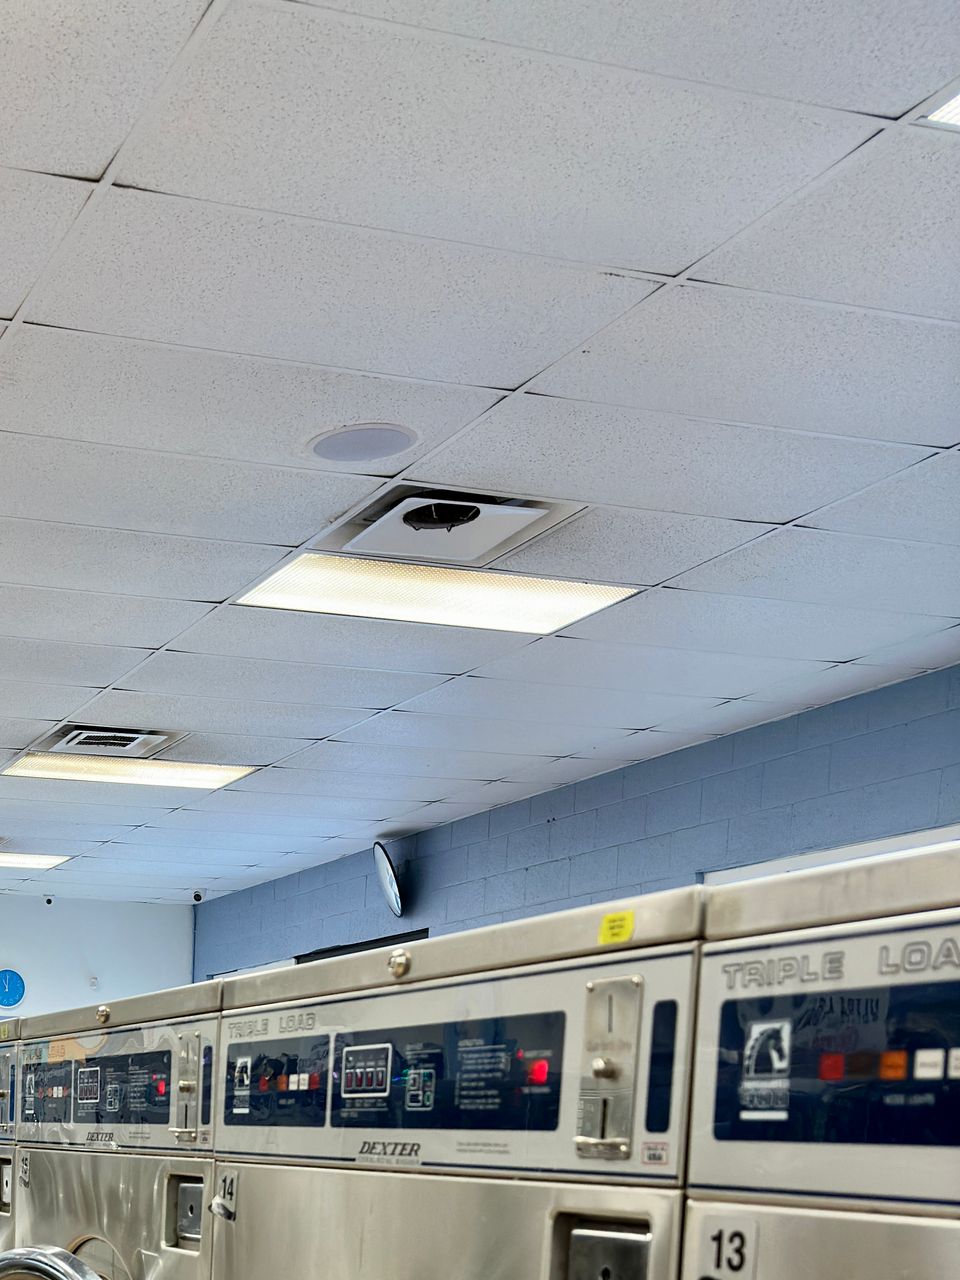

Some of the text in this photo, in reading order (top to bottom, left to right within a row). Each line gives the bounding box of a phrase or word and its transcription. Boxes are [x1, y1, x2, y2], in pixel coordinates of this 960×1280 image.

[722, 951, 845, 990] TRIPLE
[278, 1012, 316, 1033] LOAD
[359, 1141, 421, 1156] DEXTER
[222, 1176, 233, 1200] 14
[711, 1229, 745, 1272] 13
